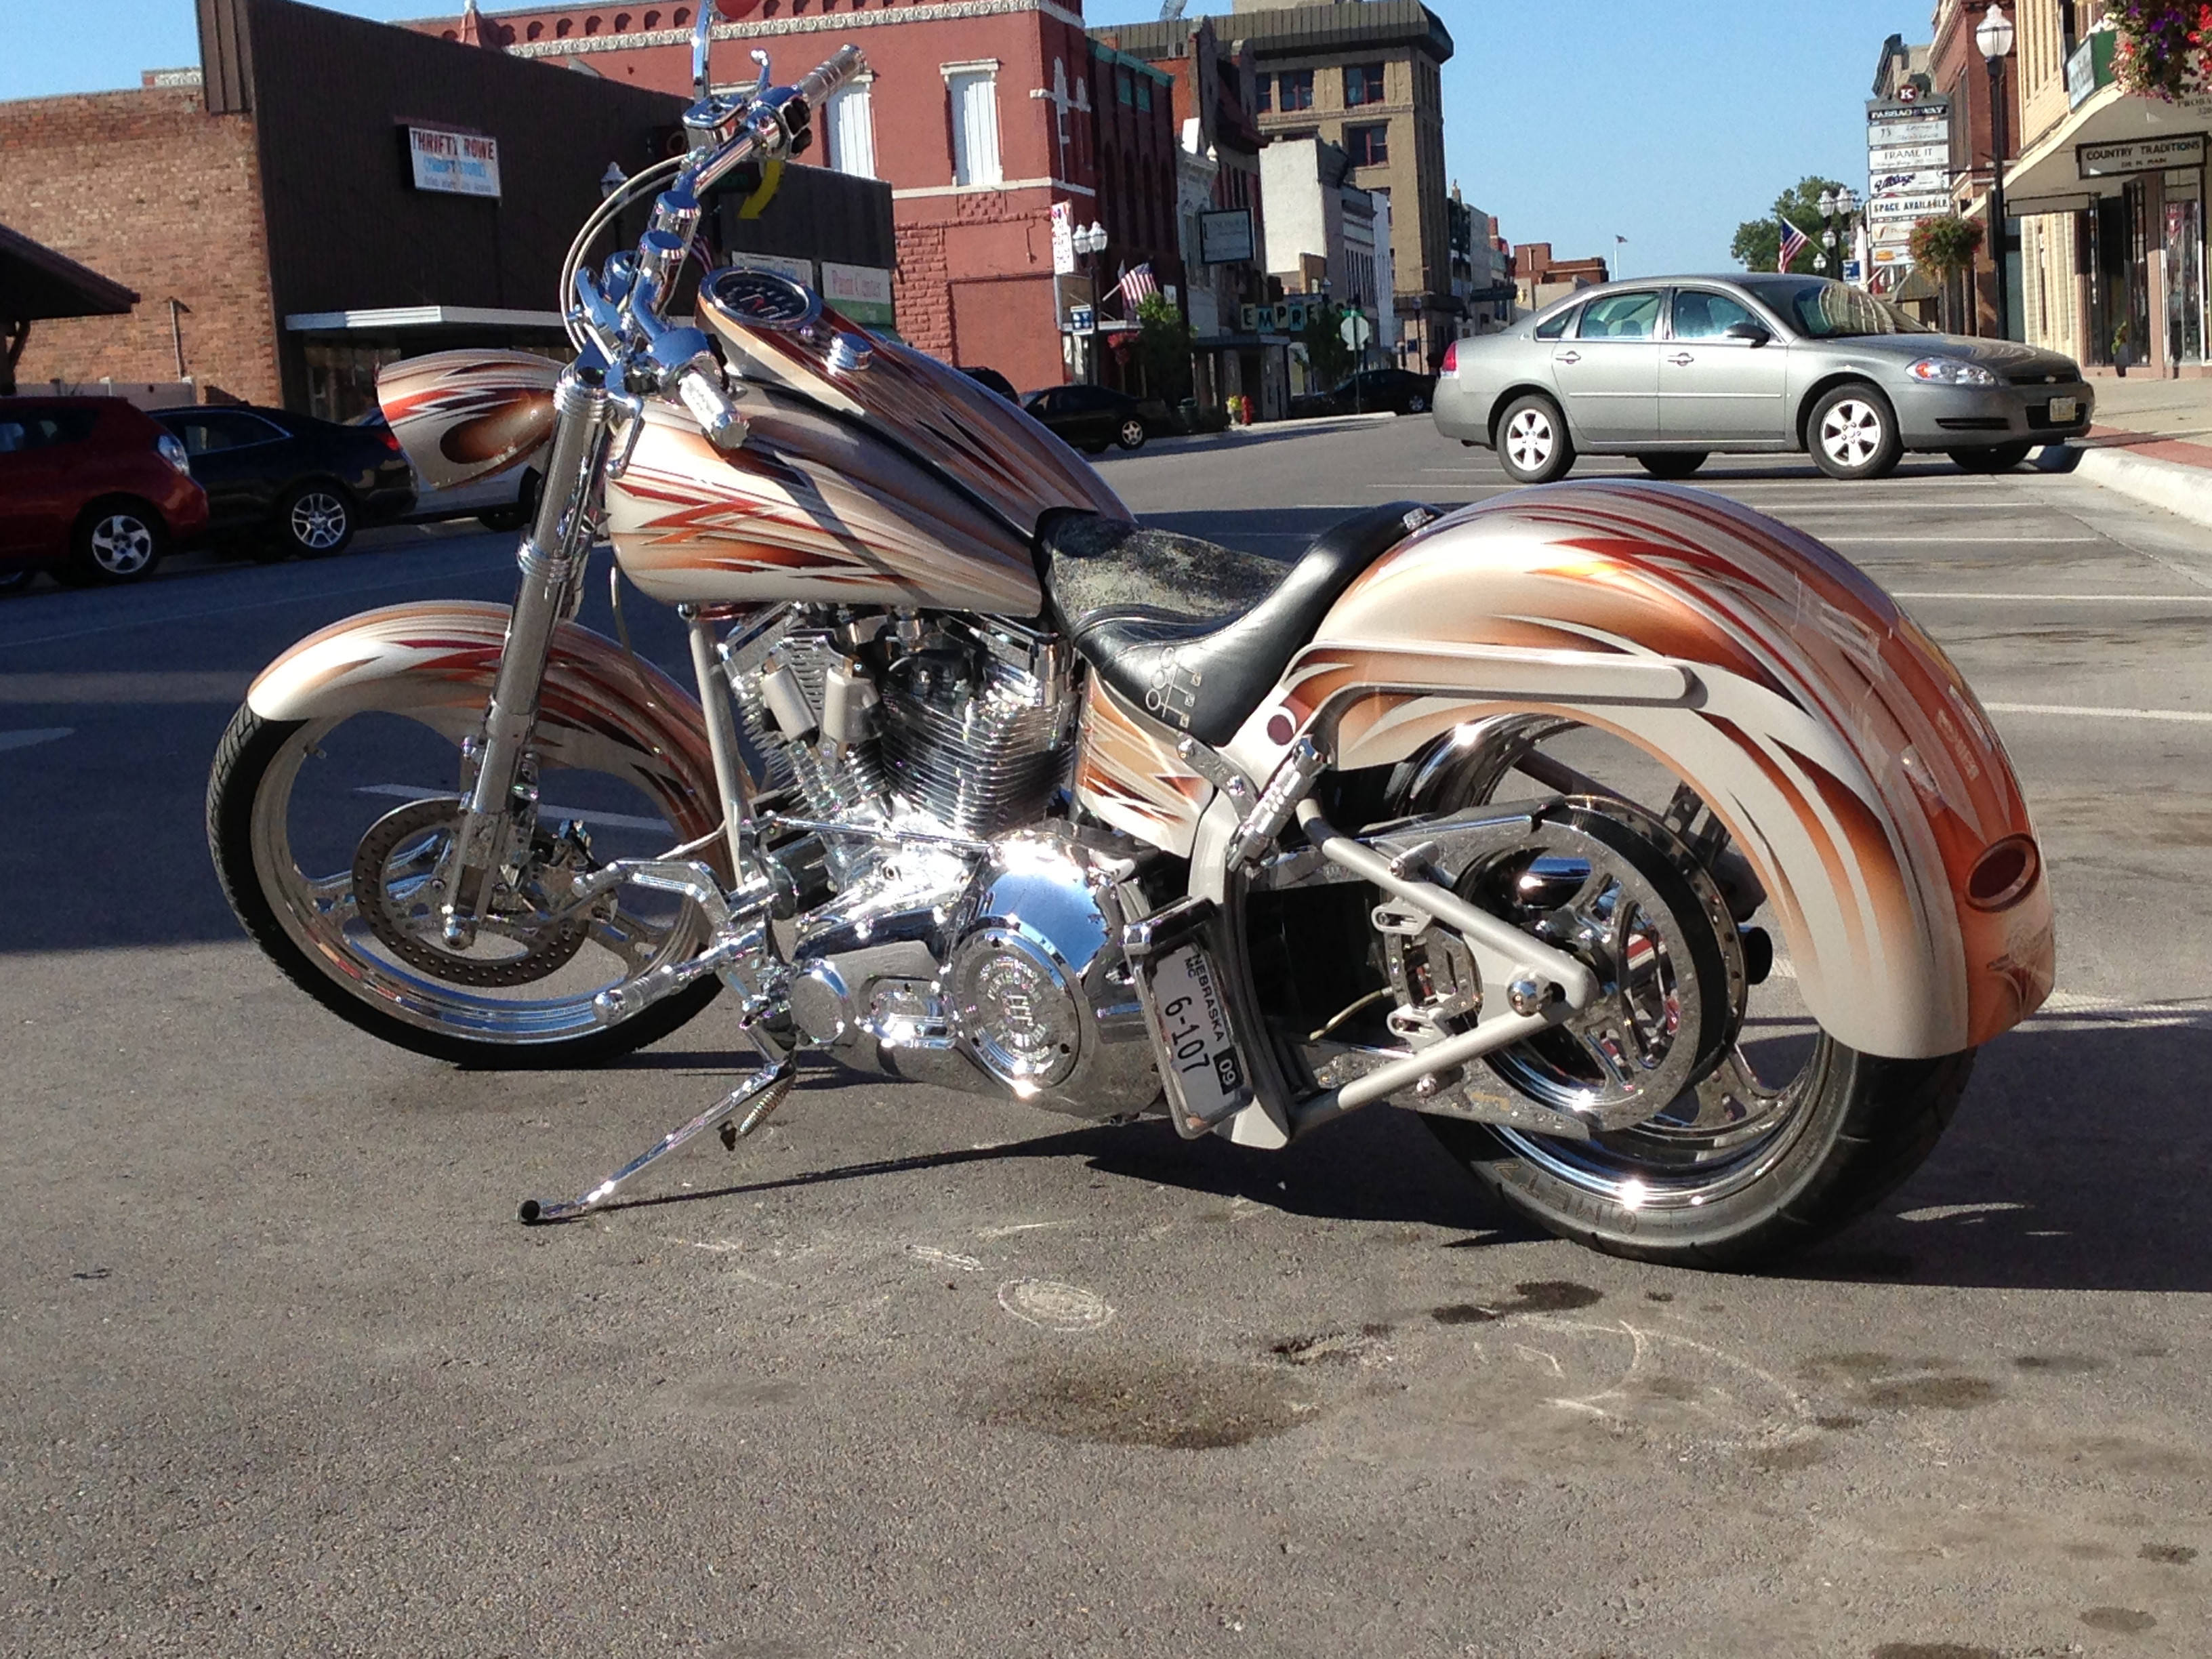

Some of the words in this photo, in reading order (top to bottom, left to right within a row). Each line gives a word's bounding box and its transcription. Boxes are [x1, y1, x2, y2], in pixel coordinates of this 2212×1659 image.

[1900, 88, 1914, 100] K
[1884, 149, 1921, 160] FRAME
[1925, 148, 1933, 157] IT
[2086, 147, 2133, 161] COUNTRY
[2139, 140, 2200, 155] TRADITIONS
[1874, 202, 1900, 213] SPACE
[1903, 198, 1948, 211] AVAILABLE
[1184, 956, 1197, 979] MC
[1191, 953, 1225, 1042] NEBRASKA
[1164, 996, 1210, 1073] 6-107
[1218, 1058, 1237, 1085] 09
